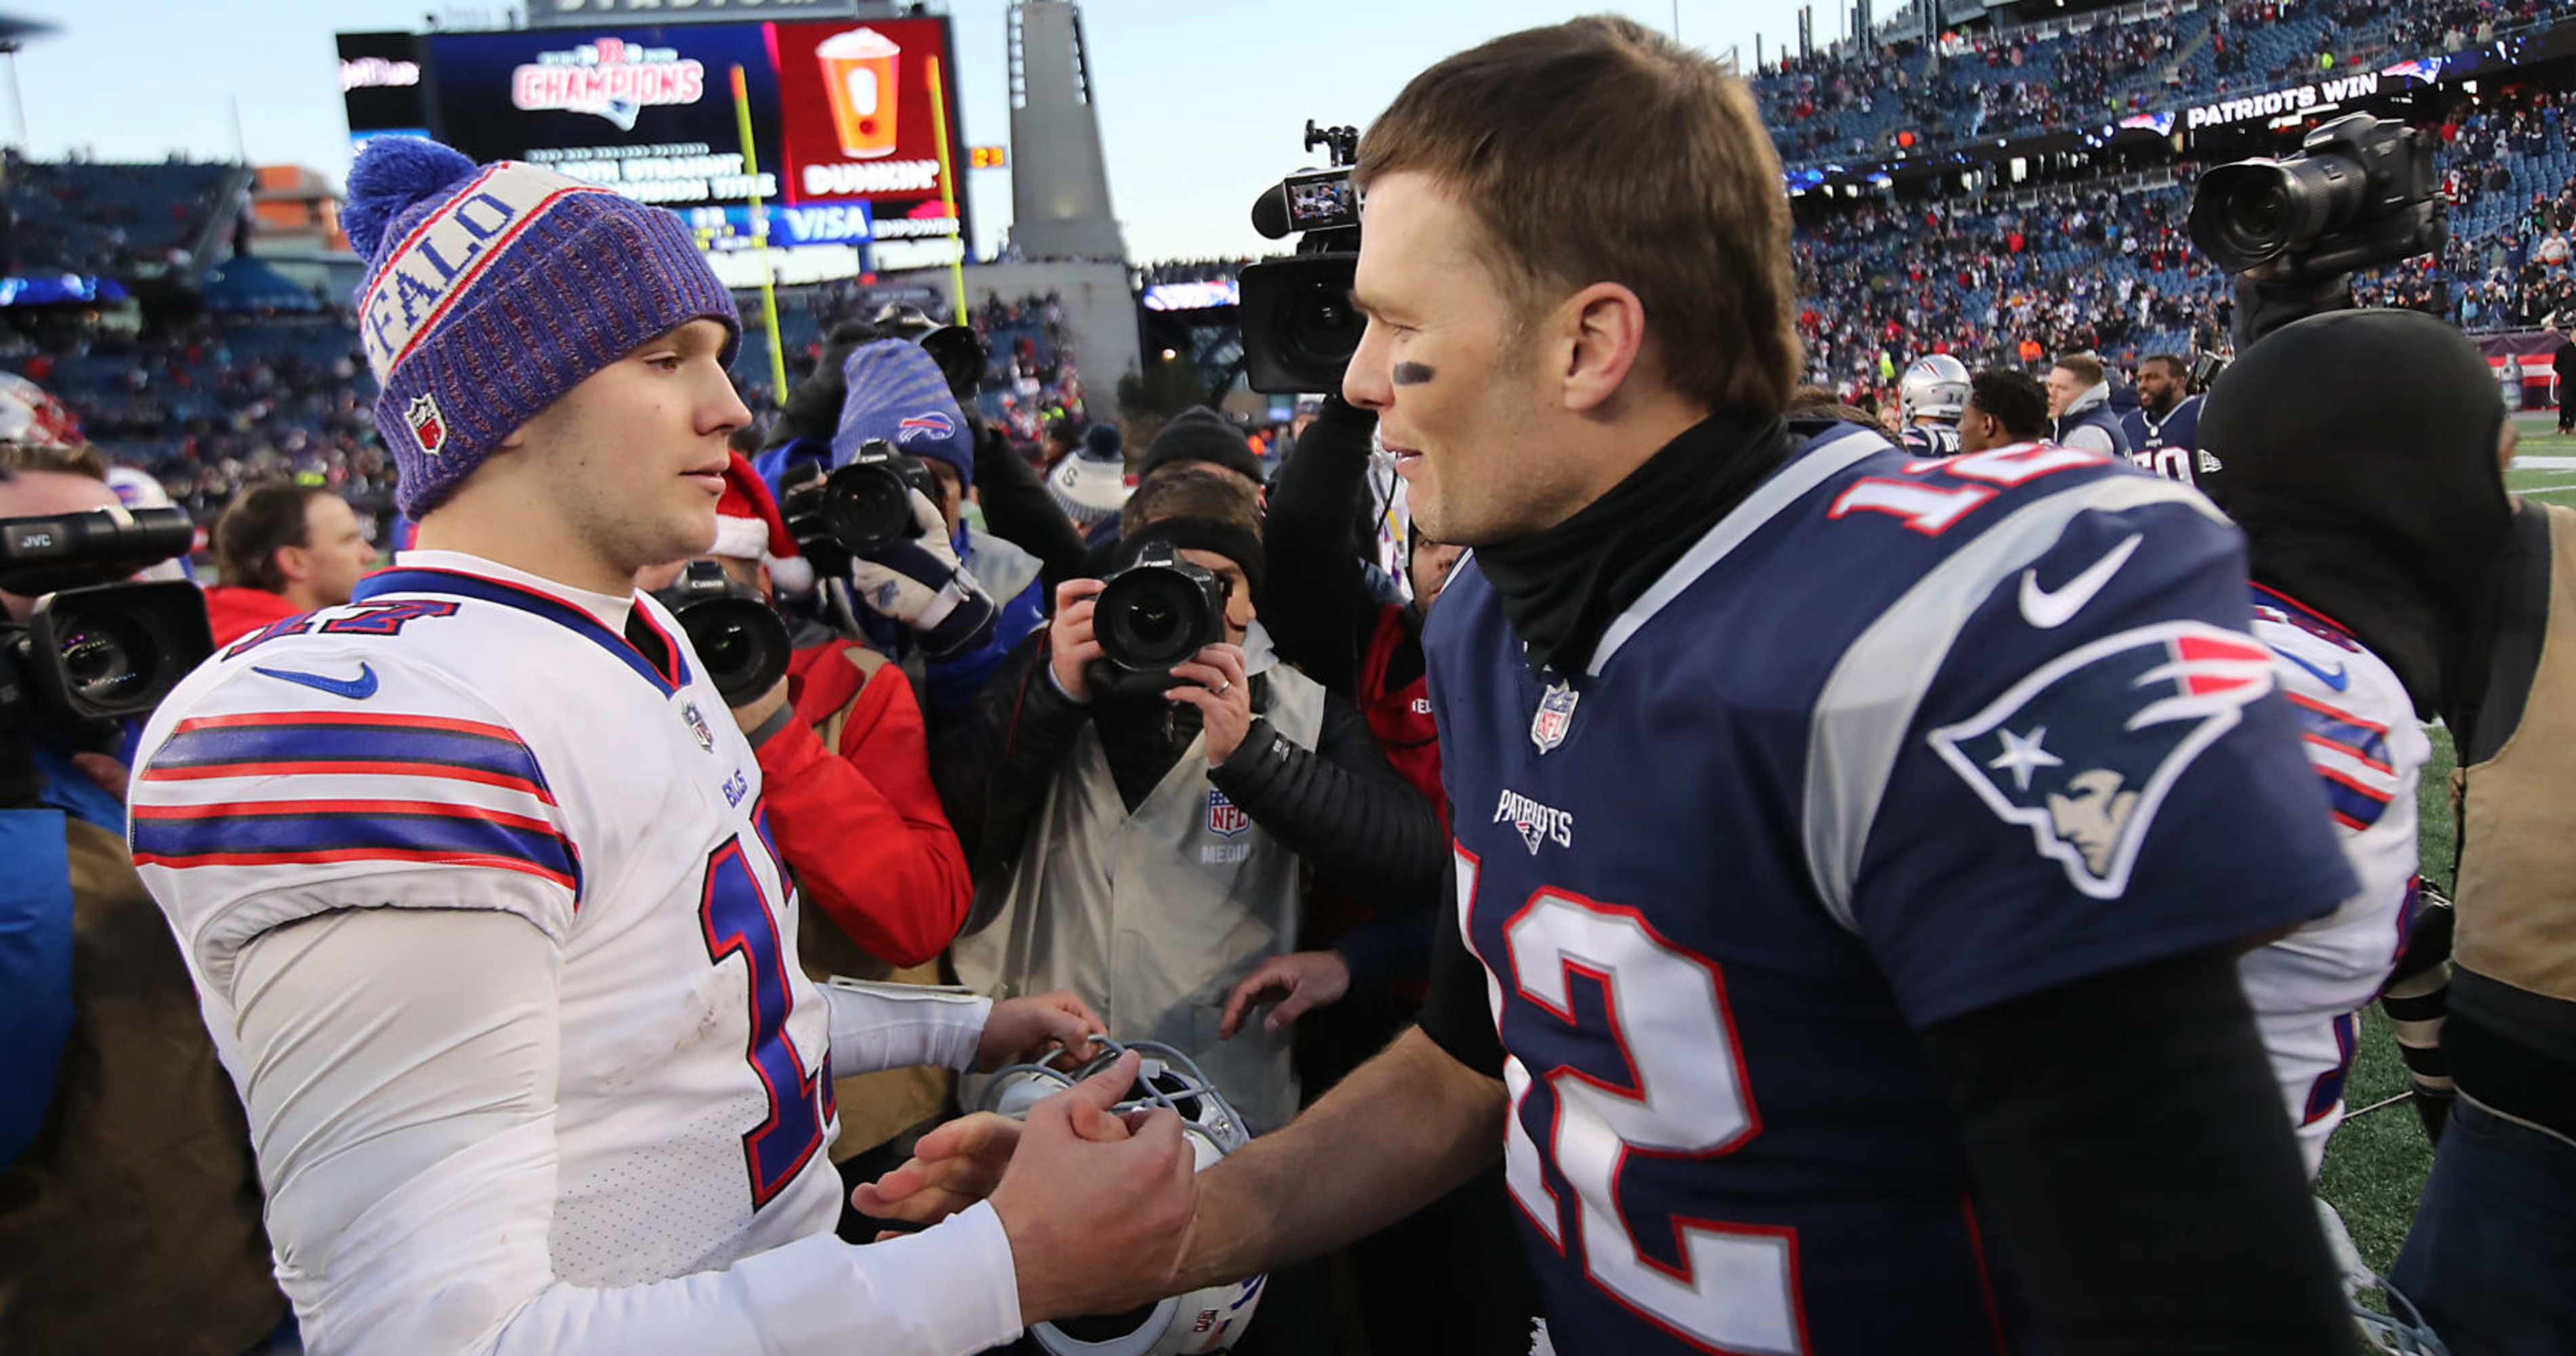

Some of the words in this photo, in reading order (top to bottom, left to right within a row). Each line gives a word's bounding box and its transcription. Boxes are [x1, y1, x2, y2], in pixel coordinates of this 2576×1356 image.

[517, 60, 704, 108] CHAMPIONS
[2188, 85, 2316, 129] PATRIOTS
[2321, 73, 2377, 102] WIN
[782, 206, 870, 240] VISA
[366, 193, 514, 361] FALO
[23, 534, 52, 548] JVC
[1211, 805, 1247, 831] NFL
[1493, 789, 1573, 848] PATRIOTS
